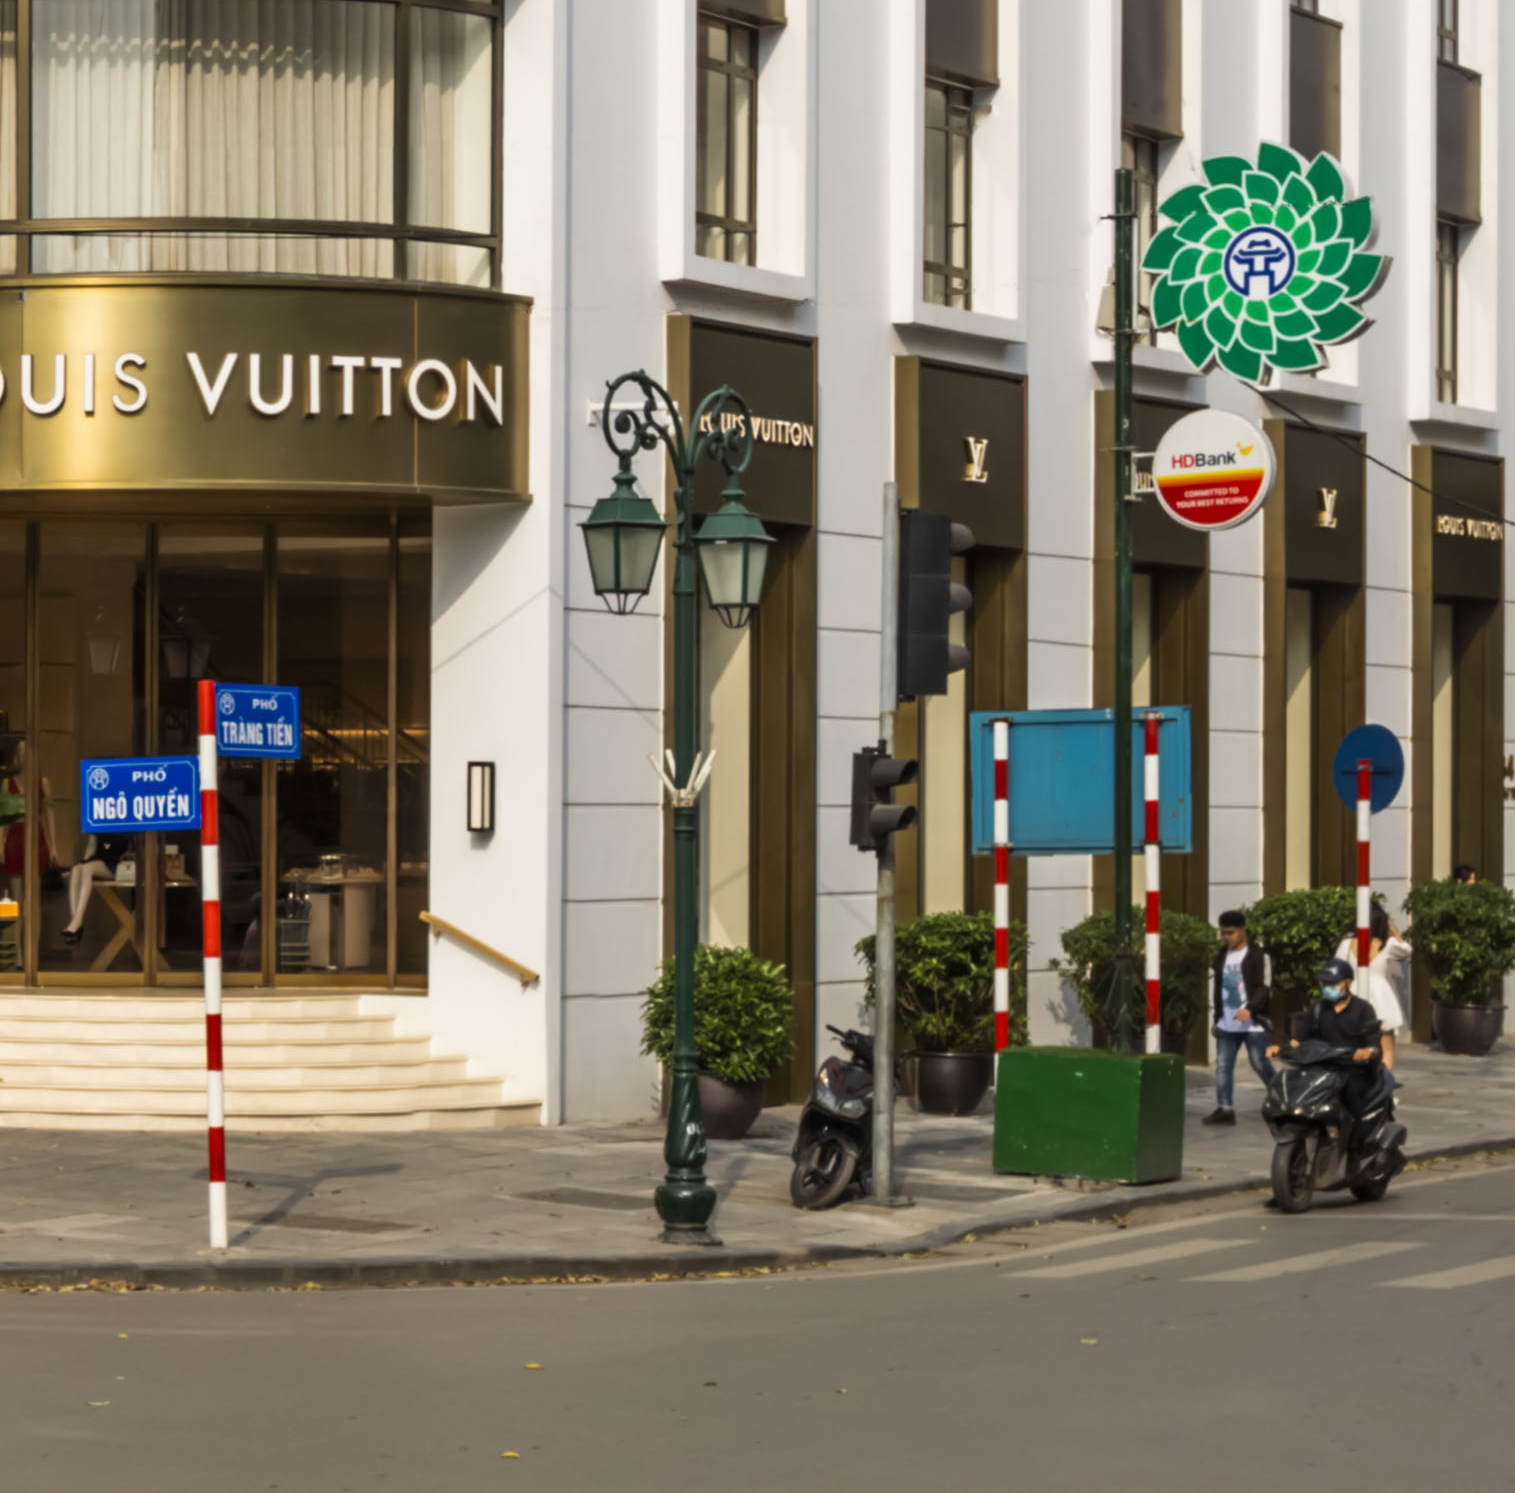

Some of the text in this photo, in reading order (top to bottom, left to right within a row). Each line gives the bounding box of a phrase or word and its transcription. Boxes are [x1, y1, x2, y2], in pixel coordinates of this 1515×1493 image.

[186, 353, 503, 425] VUITTON
[751, 417, 813, 447] VUITTON
[1172, 451, 1236, 469] HDBank
[252, 693, 278, 711] PHỐ
[222, 715, 263, 745] TRÀNG
[132, 764, 167, 782] PHỐ
[93, 791, 127, 820] NGÔ
